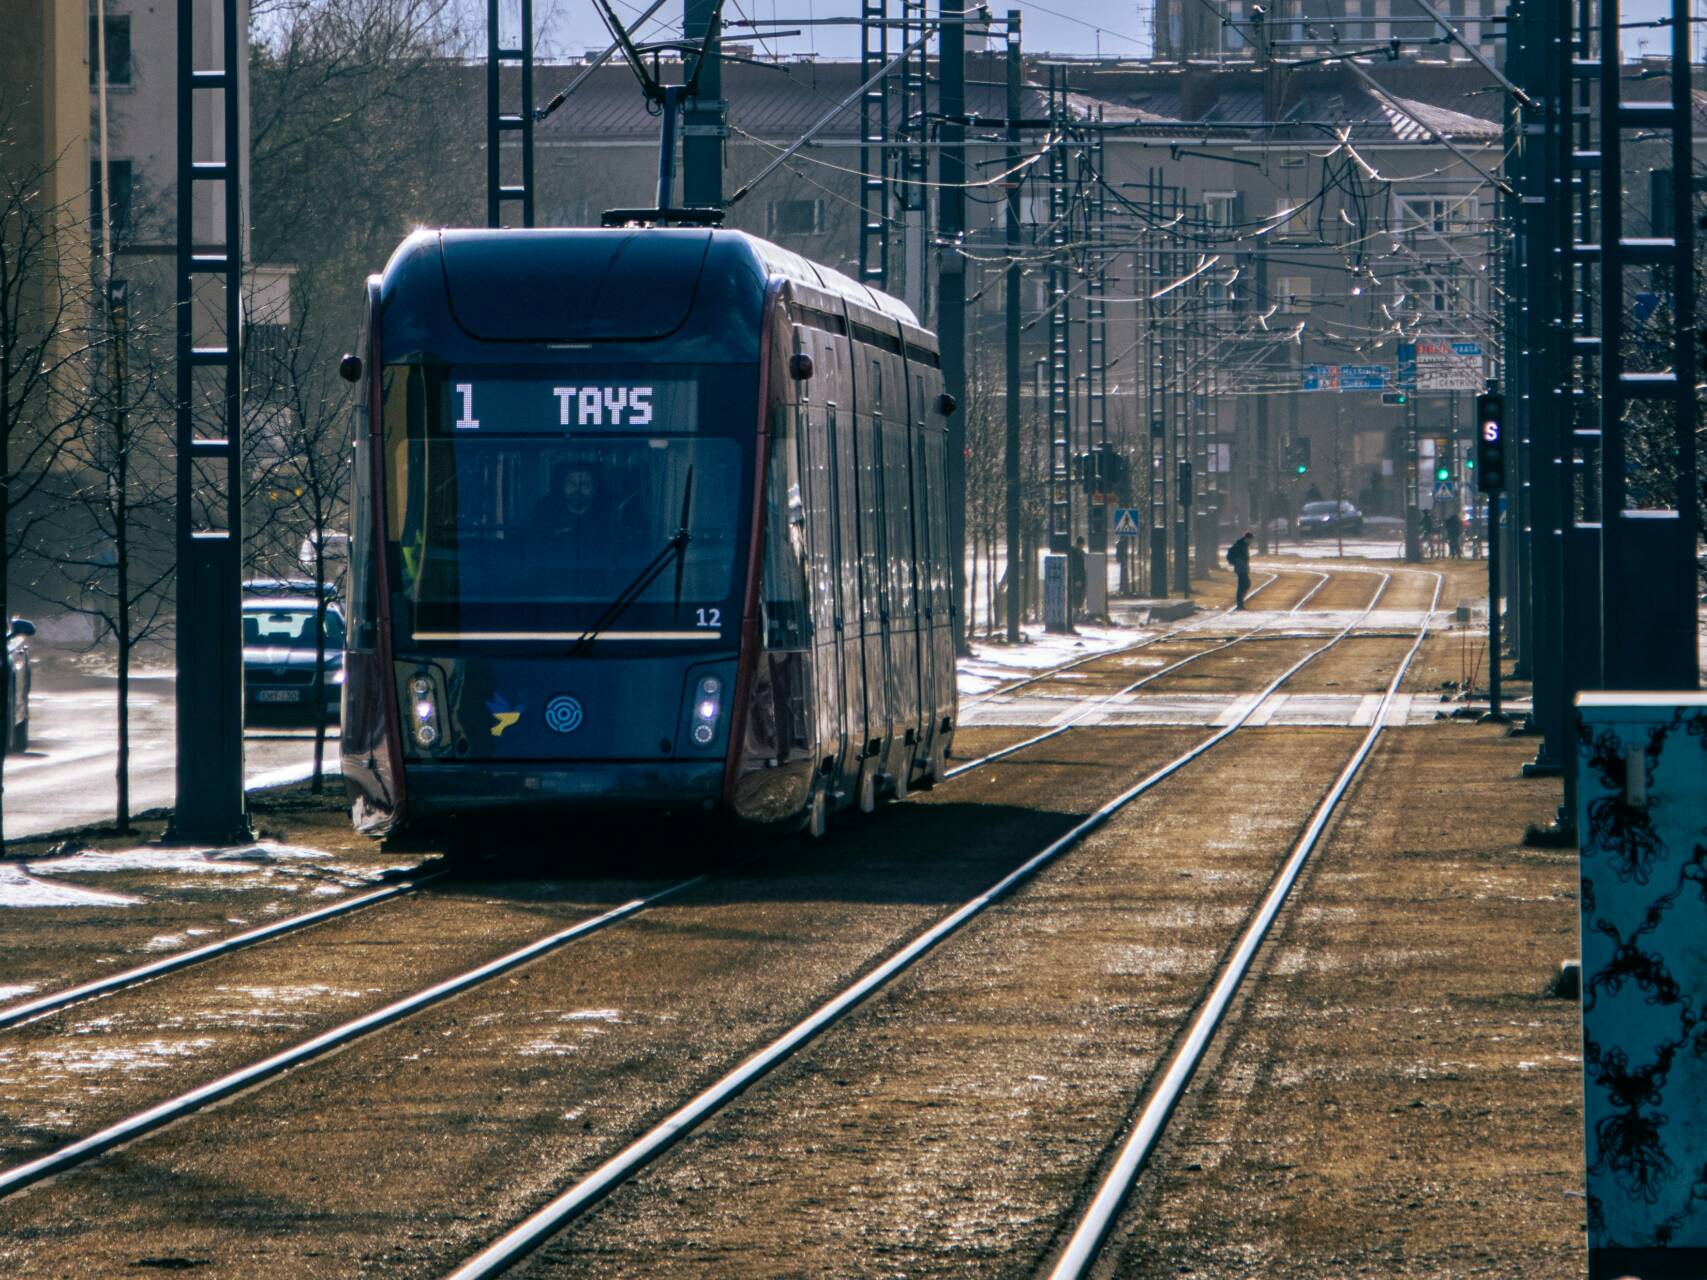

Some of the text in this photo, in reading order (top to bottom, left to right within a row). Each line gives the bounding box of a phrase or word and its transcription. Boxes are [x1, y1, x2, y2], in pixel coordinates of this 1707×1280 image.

[456, 384, 652, 428] 1 TAYS
[1483, 421, 1498, 441] S
[696, 608, 722, 627] 12
